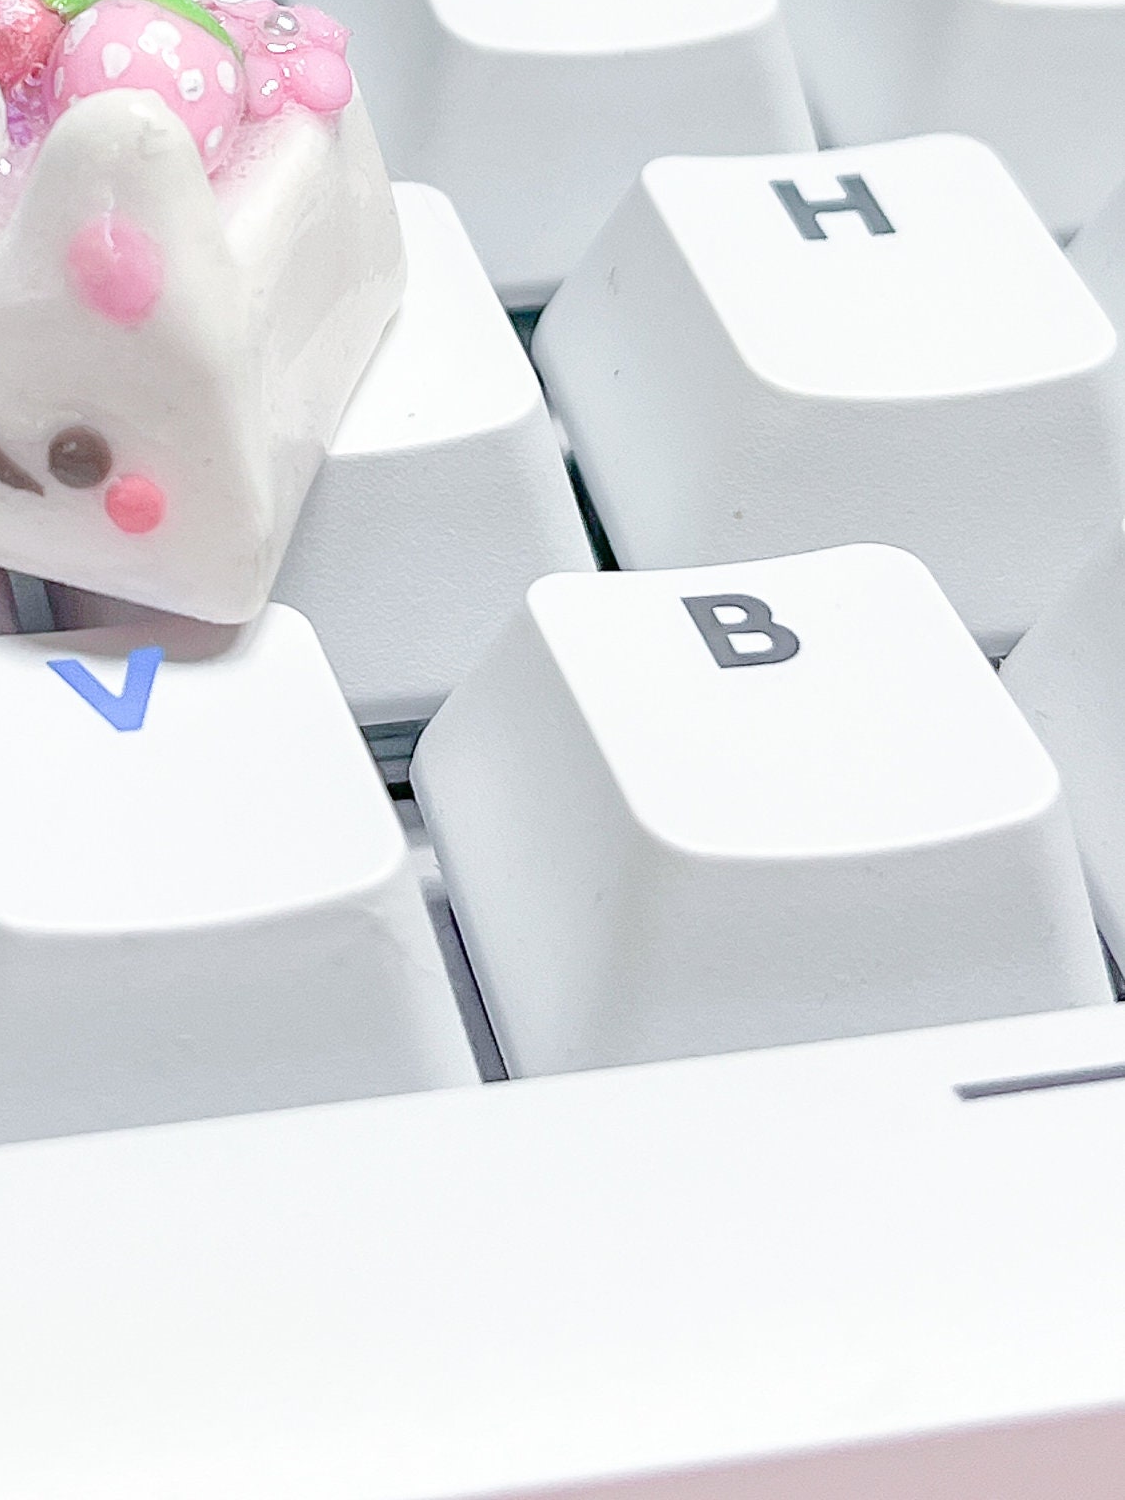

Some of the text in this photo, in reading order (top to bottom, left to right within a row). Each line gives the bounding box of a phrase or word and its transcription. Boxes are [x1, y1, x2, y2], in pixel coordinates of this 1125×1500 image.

[770, 174, 896, 240] H
[681, 594, 800, 668] B
[47, 645, 164, 732] V
